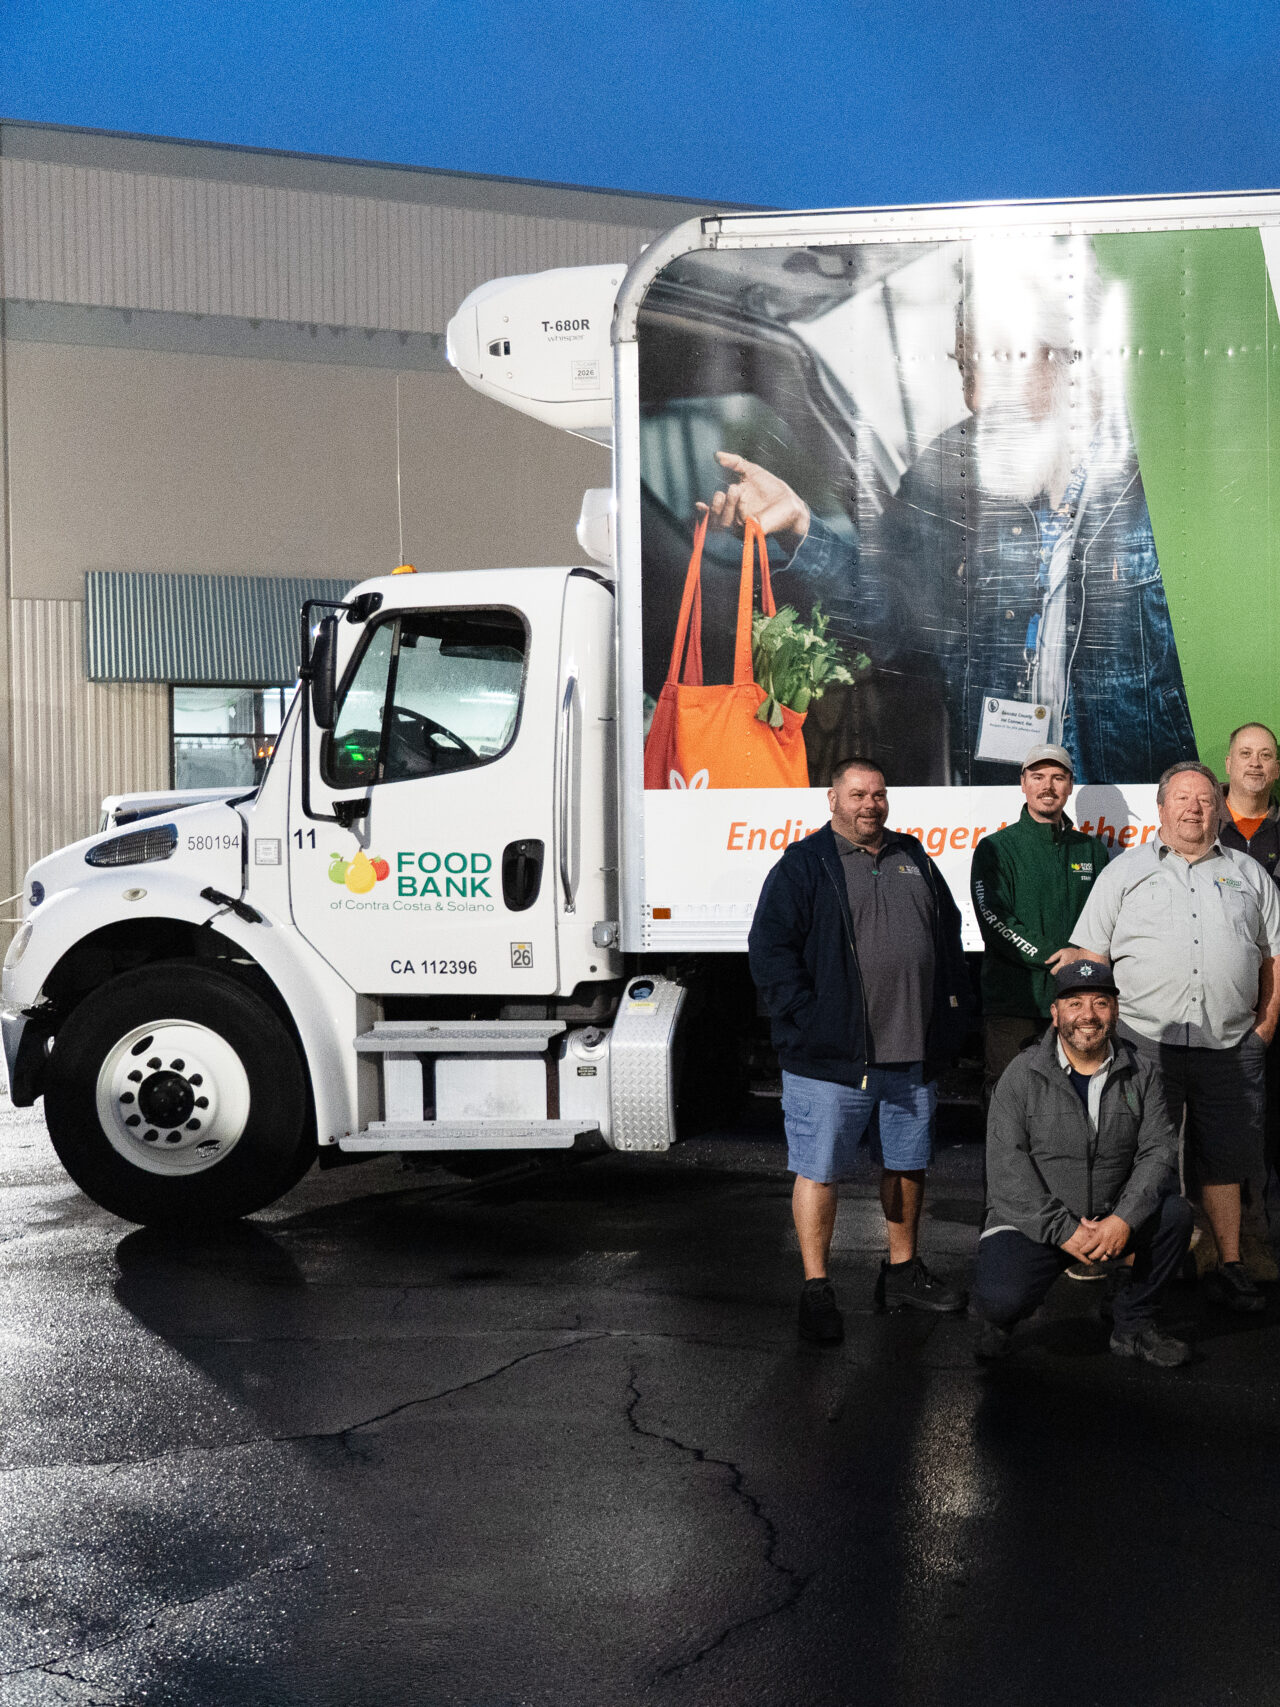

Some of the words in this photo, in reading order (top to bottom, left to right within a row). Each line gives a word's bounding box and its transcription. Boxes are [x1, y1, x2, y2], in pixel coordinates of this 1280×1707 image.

[541, 319, 590, 332] T-680R
[188, 835, 240, 851] 580194
[293, 828, 316, 849] 11
[727, 819, 821, 851] Endi
[397, 851, 492, 874] FOOD
[397, 876, 493, 898] BANK
[330, 899, 342, 910] of
[345, 899, 390, 911] Contra
[392, 900, 432, 911] Costa
[435, 902, 444, 911] &
[447, 901, 495, 912] Solano
[975, 880, 998, 924] HUNGER
[993, 921, 1039, 957] FIGHTER
[390, 960, 416, 974] CA
[421, 960, 478, 975] 112396
[513, 949, 532, 966] 26
